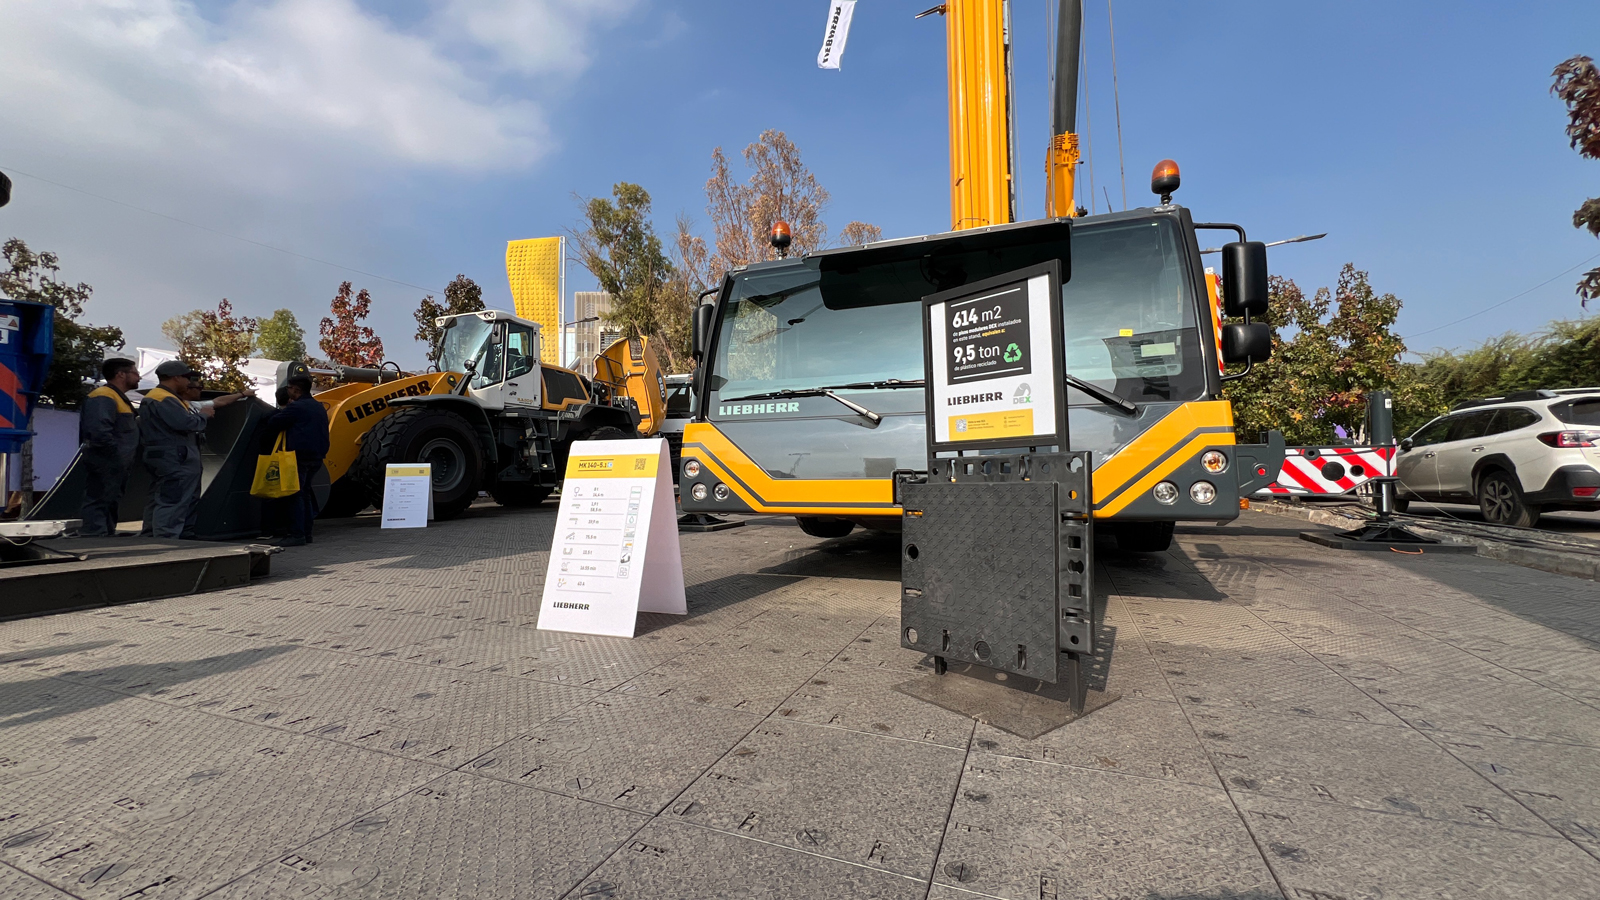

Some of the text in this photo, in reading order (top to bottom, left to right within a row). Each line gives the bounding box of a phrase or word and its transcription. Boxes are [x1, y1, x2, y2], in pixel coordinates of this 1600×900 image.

[952, 305, 1002, 329] 614 m2
[988, 322, 998, 330] DEX
[997, 318, 1022, 328] instalados
[953, 344, 1000, 365] 9,5 ton
[959, 363, 977, 371] plástico
[976, 360, 997, 368] reciclado
[344, 380, 432, 423] LIEBHERR
[947, 391, 1003, 406] LIEBHERR
[1012, 396, 1032, 404] DEX
[718, 402, 800, 416] LIEBHERR
[552, 601, 590, 610] LIEBHERR
